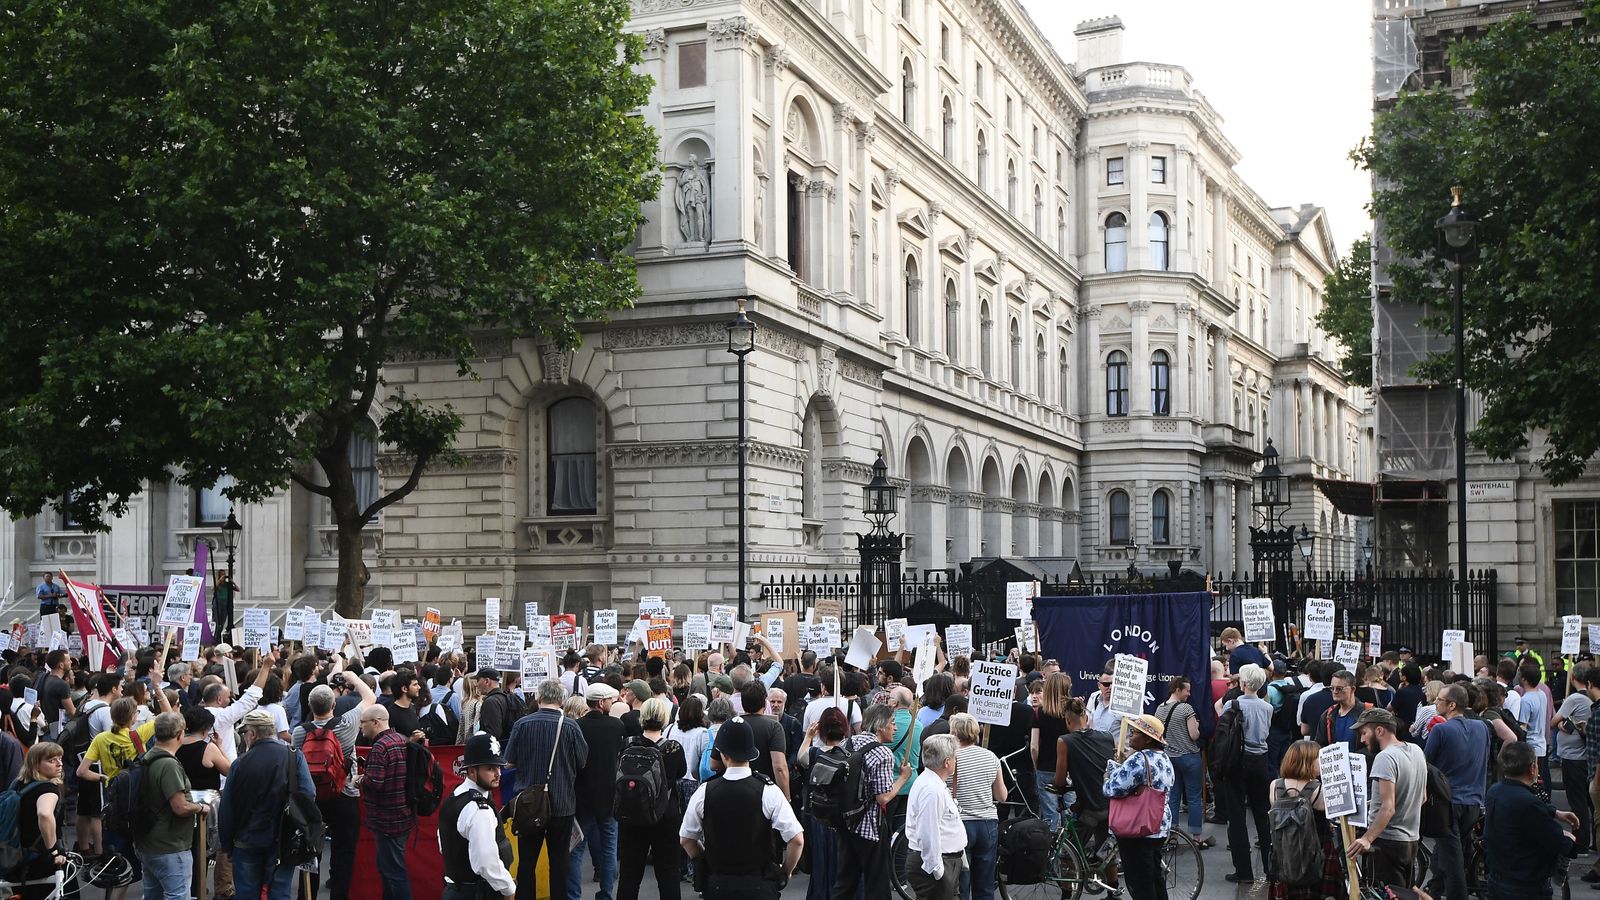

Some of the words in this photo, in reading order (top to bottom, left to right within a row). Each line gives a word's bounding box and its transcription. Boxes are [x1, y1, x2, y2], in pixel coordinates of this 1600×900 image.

[120, 594, 164, 614] PEOPL
[424, 620, 439, 633] OUT!
[650, 640, 671, 650] OUT!
[1103, 625, 1159, 654] LONDON
[1340, 642, 1358, 650] Justice
[1336, 656, 1358, 664] Grenfell
[979, 662, 1012, 677] Justice
[1118, 660, 1133, 670] Tories
[1134, 664, 1143, 673] have
[1116, 669, 1130, 679] blood
[986, 676, 1001, 686] for
[1114, 678, 1127, 686] their
[1128, 680, 1141, 690] hands
[973, 685, 1012, 700] Grenfell
[1114, 688, 1132, 698] Justice
[972, 697, 983, 706] We
[984, 698, 1009, 710] demand
[976, 707, 986, 715] the
[987, 708, 1002, 718] truth
[1320, 756, 1332, 764] Tories
[1333, 753, 1343, 761] have
[1321, 764, 1333, 775] blood
[1322, 776, 1332, 785] their
[1333, 771, 1346, 782] hands
[1325, 786, 1339, 796] Justice
[1326, 794, 1344, 807] Grenfell
